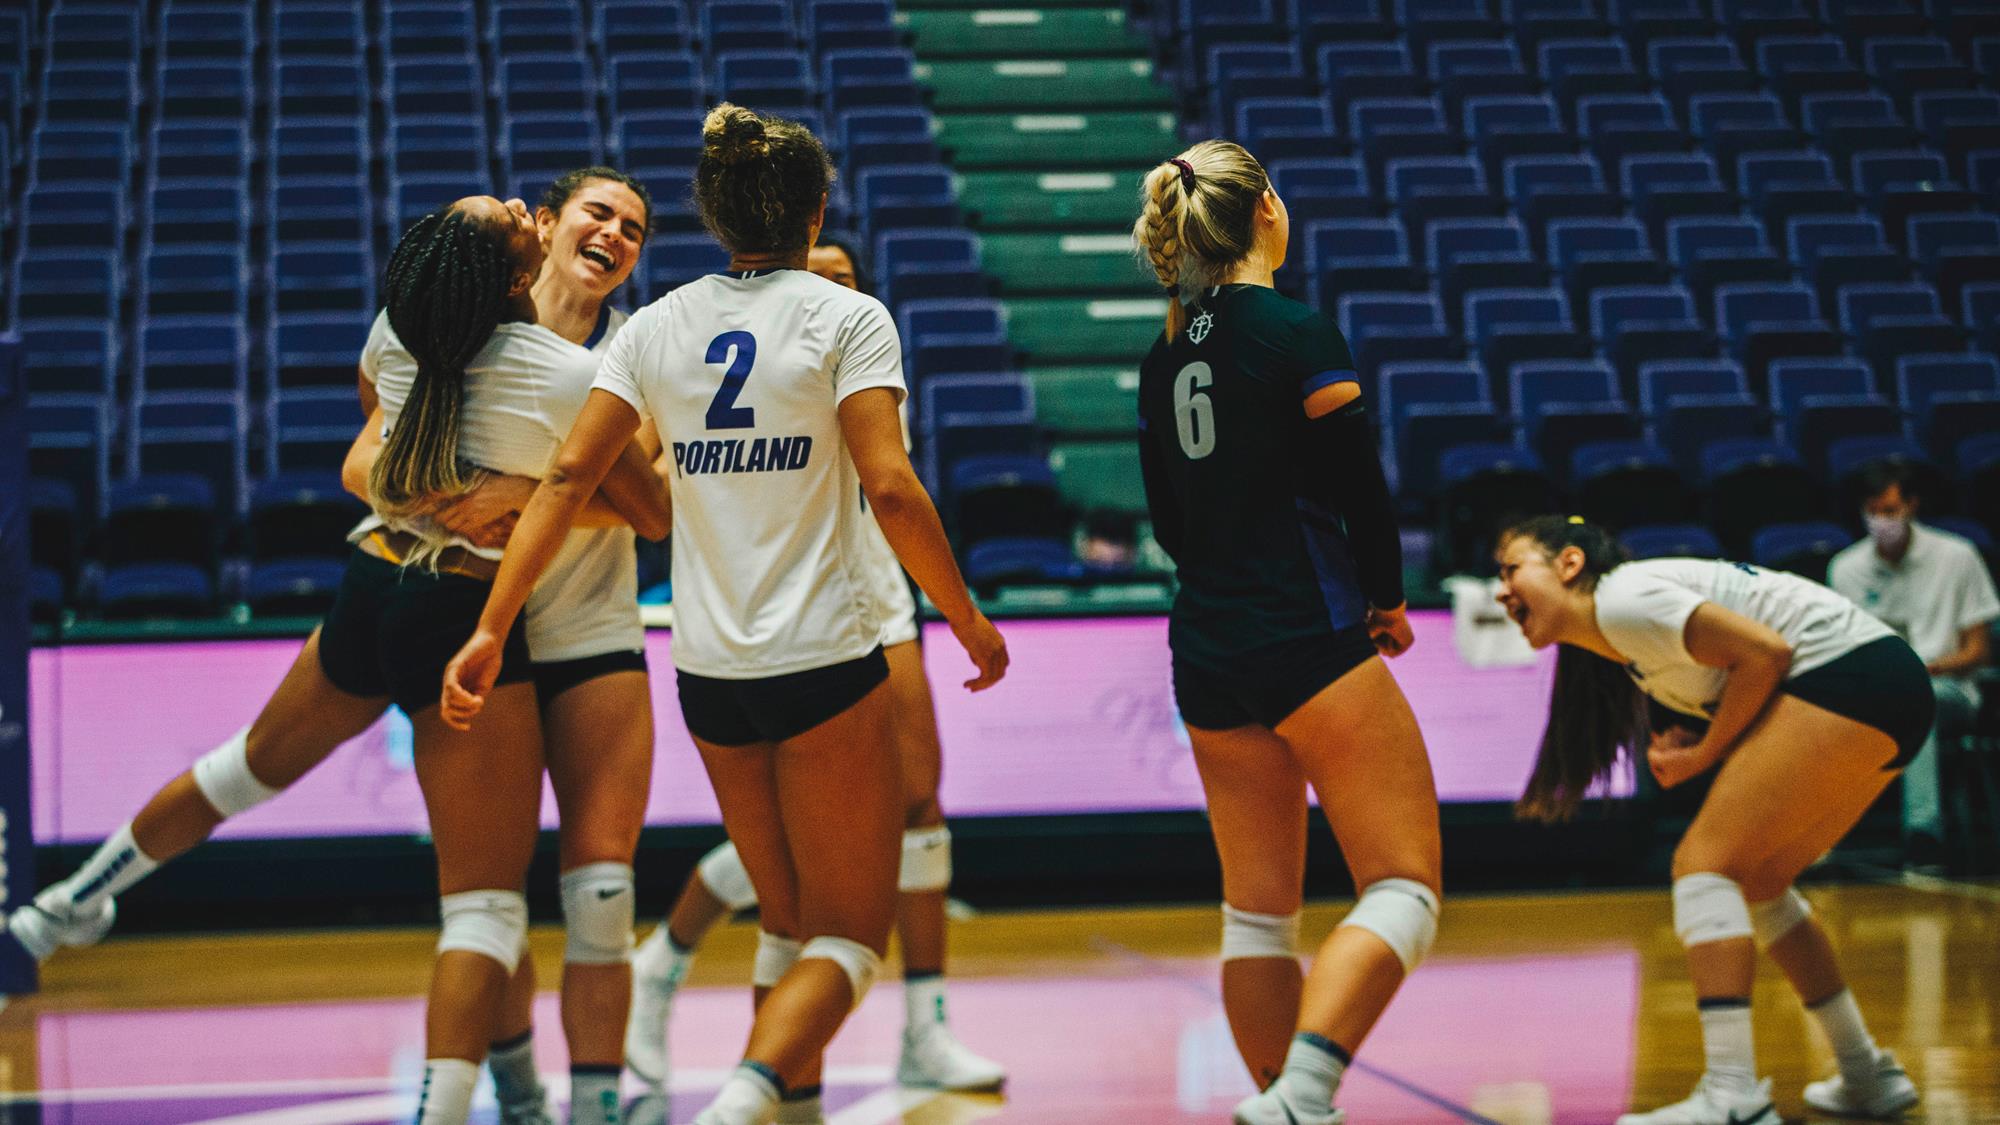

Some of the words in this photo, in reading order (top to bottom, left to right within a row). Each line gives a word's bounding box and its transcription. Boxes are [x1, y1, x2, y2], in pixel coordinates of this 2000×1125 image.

[705, 330, 757, 430] 2
[1174, 361, 1216, 460] 6
[673, 436, 813, 480] PORTLAND
